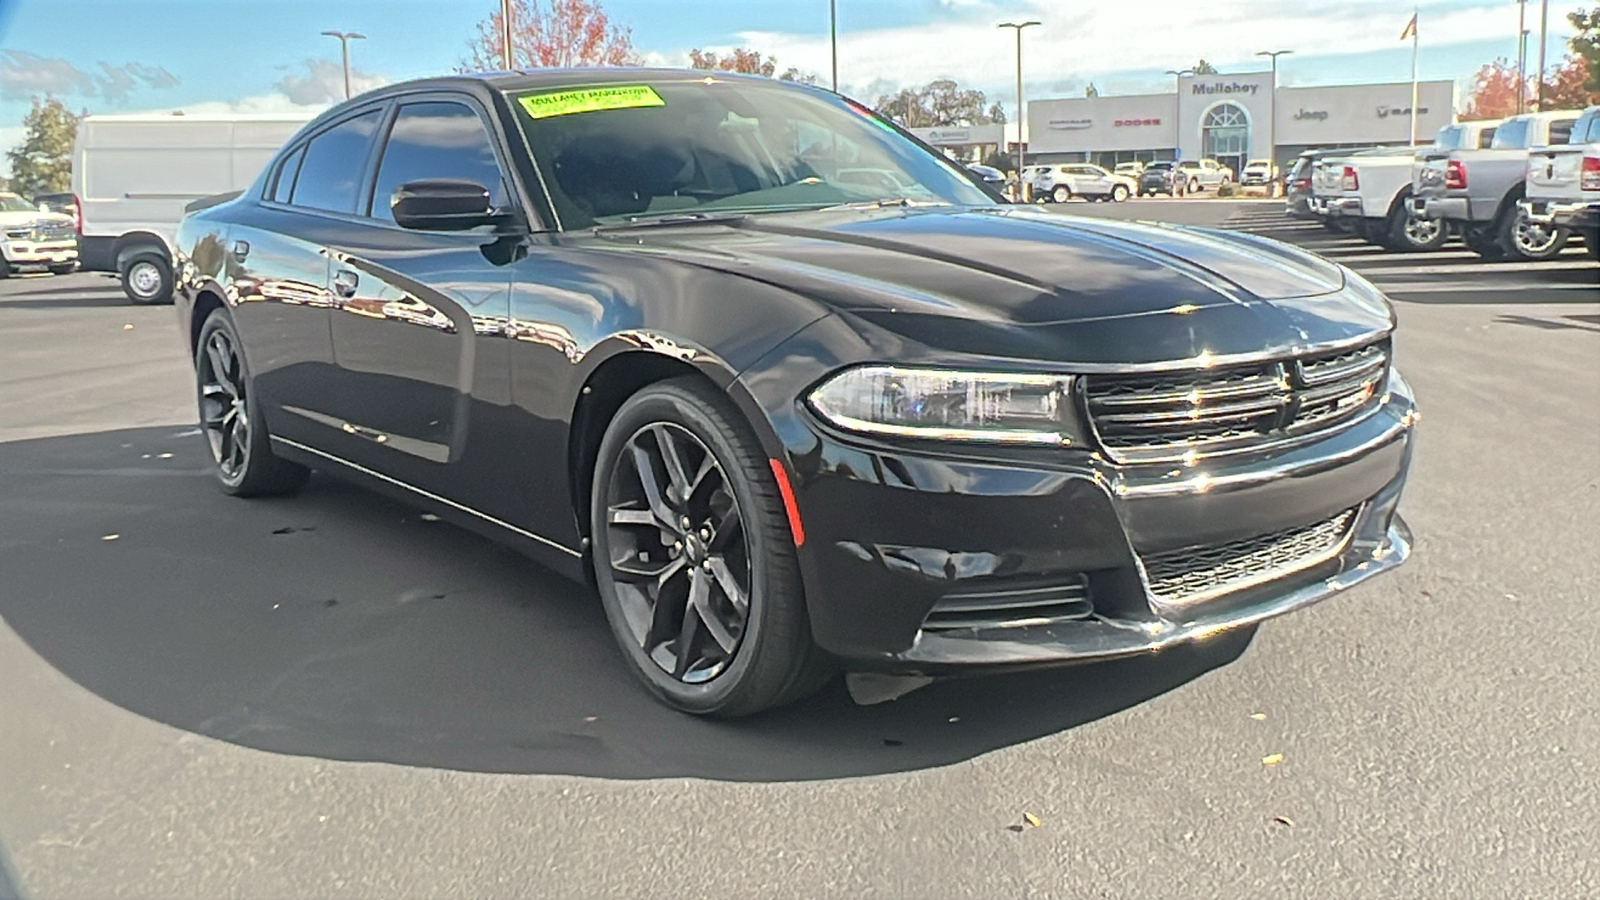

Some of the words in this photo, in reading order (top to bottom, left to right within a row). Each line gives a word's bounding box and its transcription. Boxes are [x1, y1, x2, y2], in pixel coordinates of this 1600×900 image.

[1192, 82, 1259, 95] Mullahey
[1293, 108, 1329, 122] Jeep
[1114, 118, 1161, 127] DODGE
